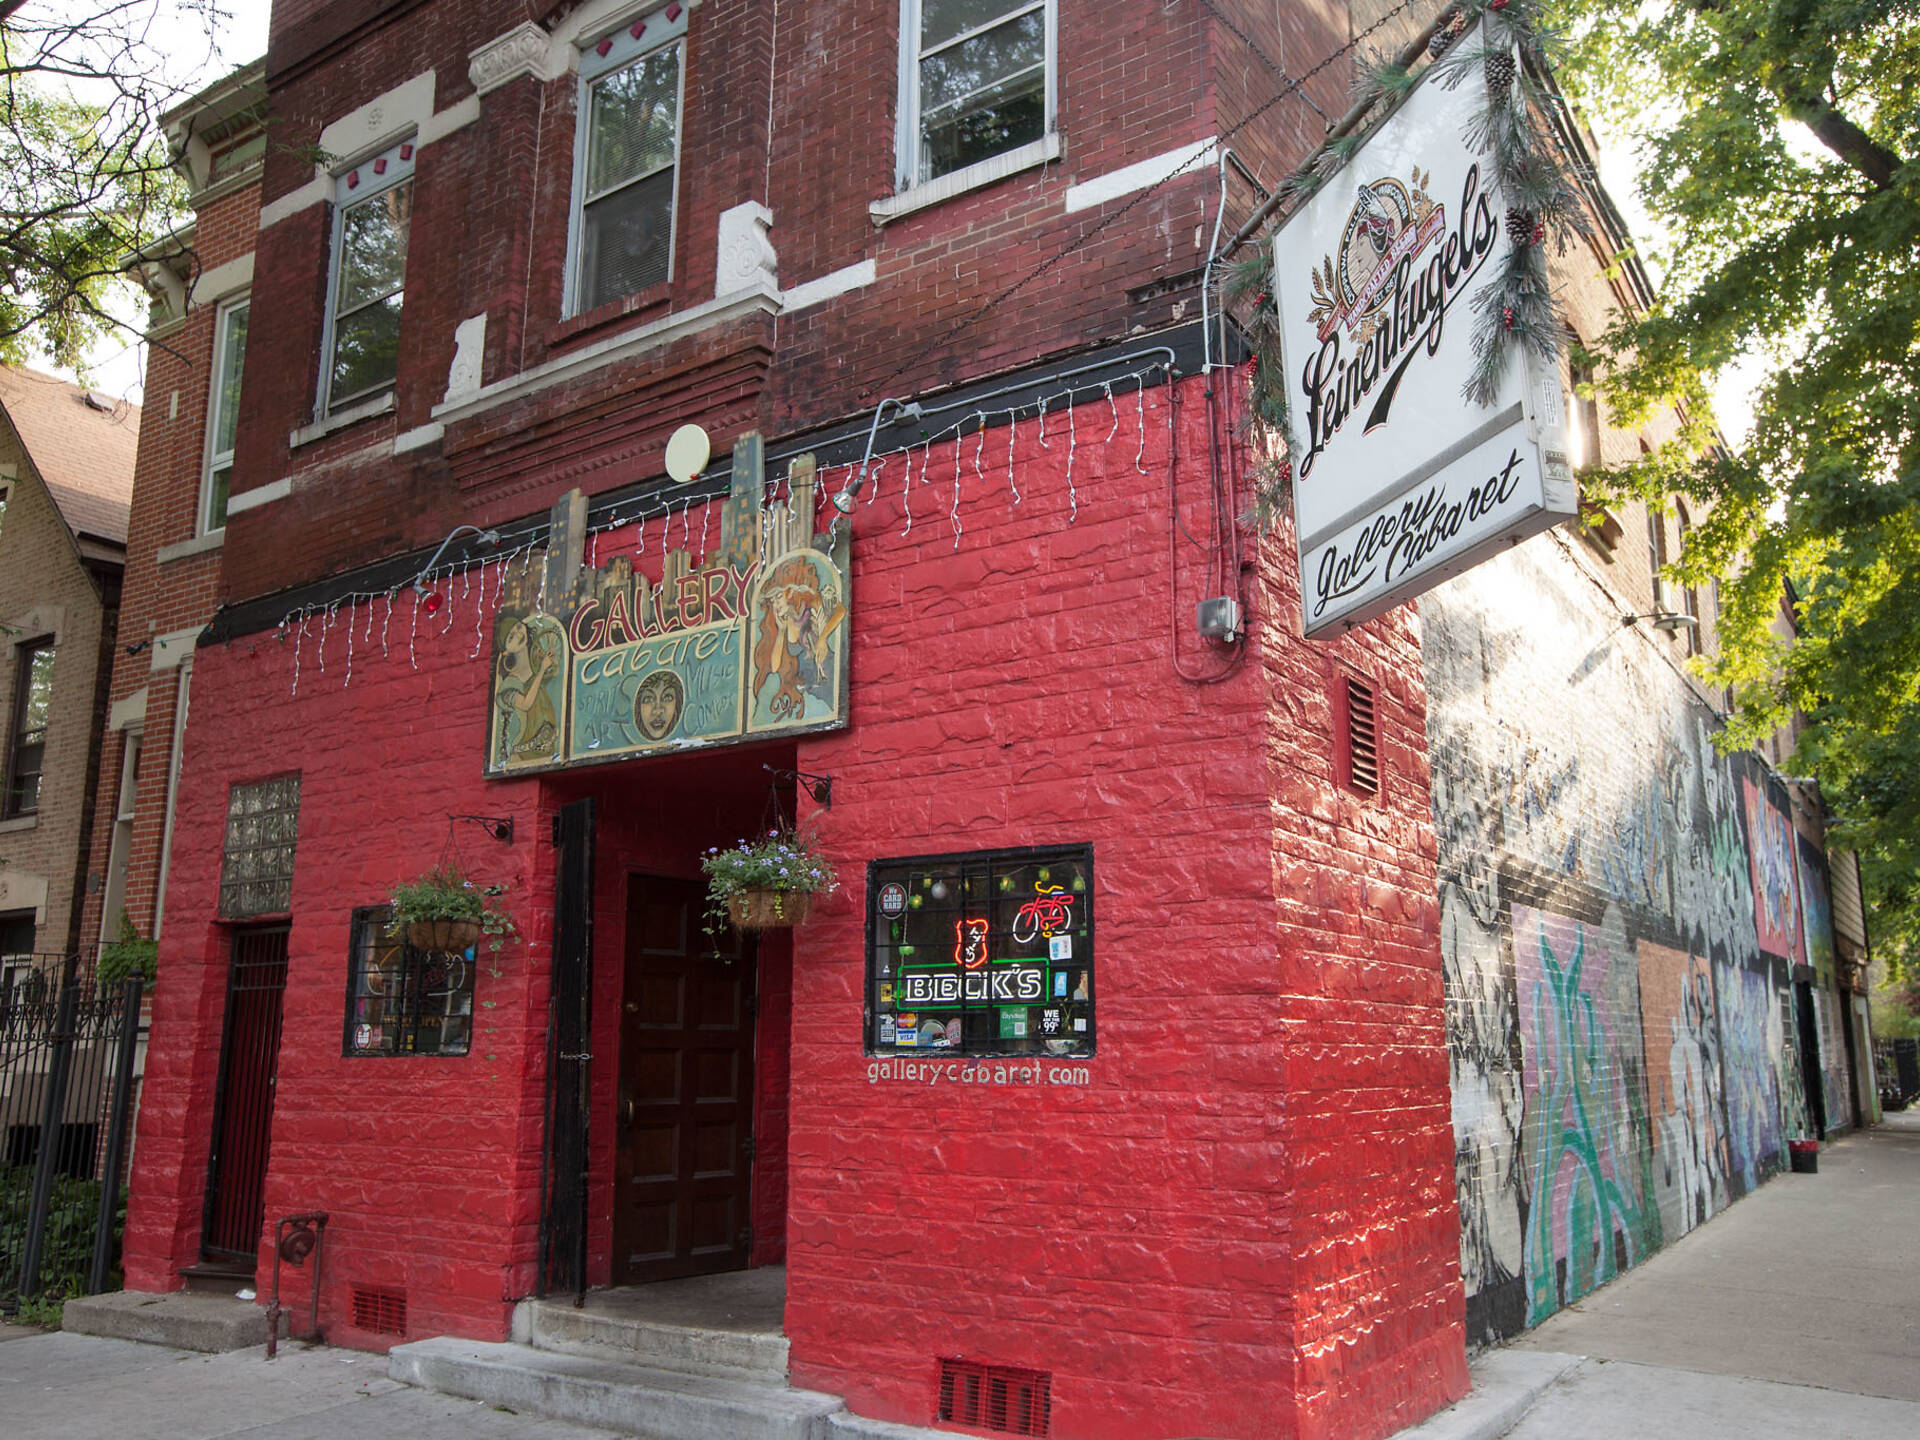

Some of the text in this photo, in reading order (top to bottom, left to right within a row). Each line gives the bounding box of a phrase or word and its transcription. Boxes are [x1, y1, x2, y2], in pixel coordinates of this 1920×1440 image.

[1350, 254, 1391, 326] HANDCRAFTED
[1385, 448, 1524, 583] Cabaret
[570, 561, 759, 653] GALLERY
[581, 625, 740, 685] cabaret
[883, 894, 902, 902] CARD
[905, 964, 1042, 1001] BECK'S
[1043, 1009, 1059, 1018] WE
[867, 1058, 1089, 1085] gallerycabaret.com
